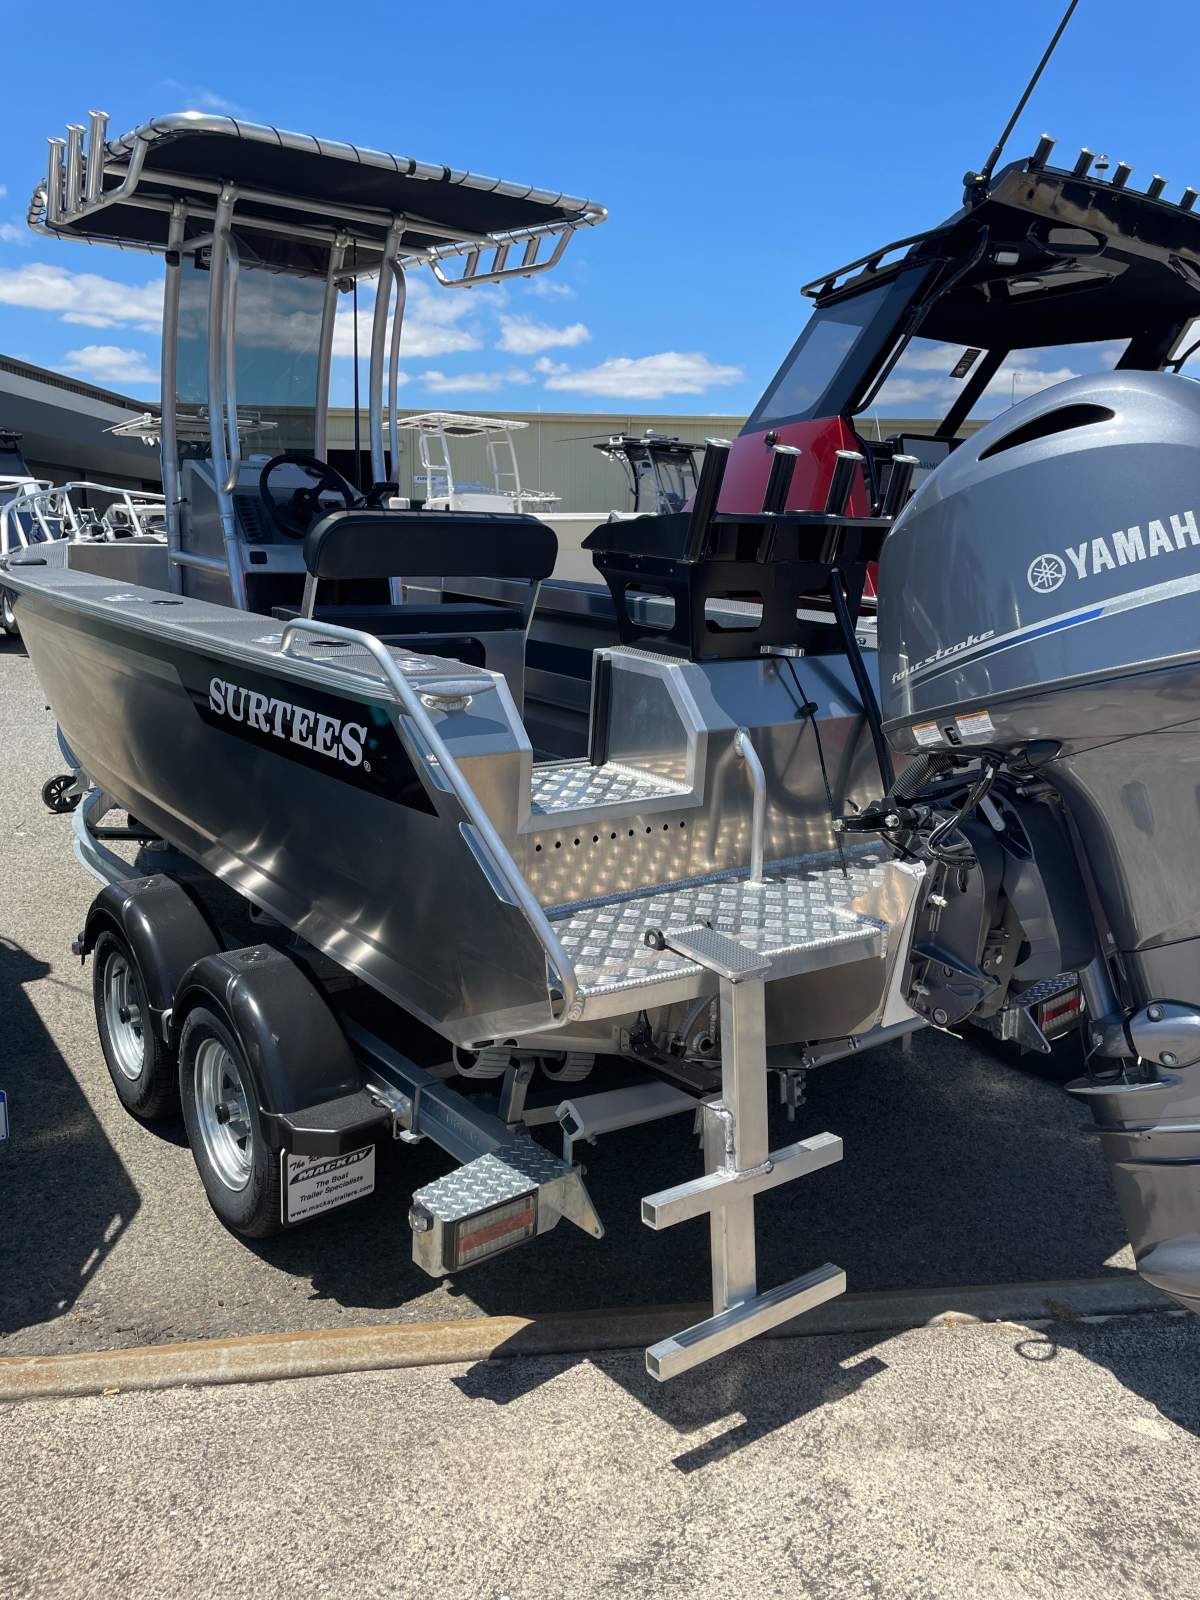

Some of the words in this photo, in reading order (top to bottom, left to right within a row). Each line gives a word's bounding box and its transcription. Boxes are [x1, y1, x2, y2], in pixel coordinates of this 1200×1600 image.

[1064, 510, 1200, 580] YAMAH
[296, 1149, 369, 1181] MACKAY
[316, 1180, 330, 1189] The
[331, 1172, 349, 1183] Boat
[290, 1184, 373, 1217] www.mackaytrailers.com
[300, 1190, 324, 1203] Trailer
